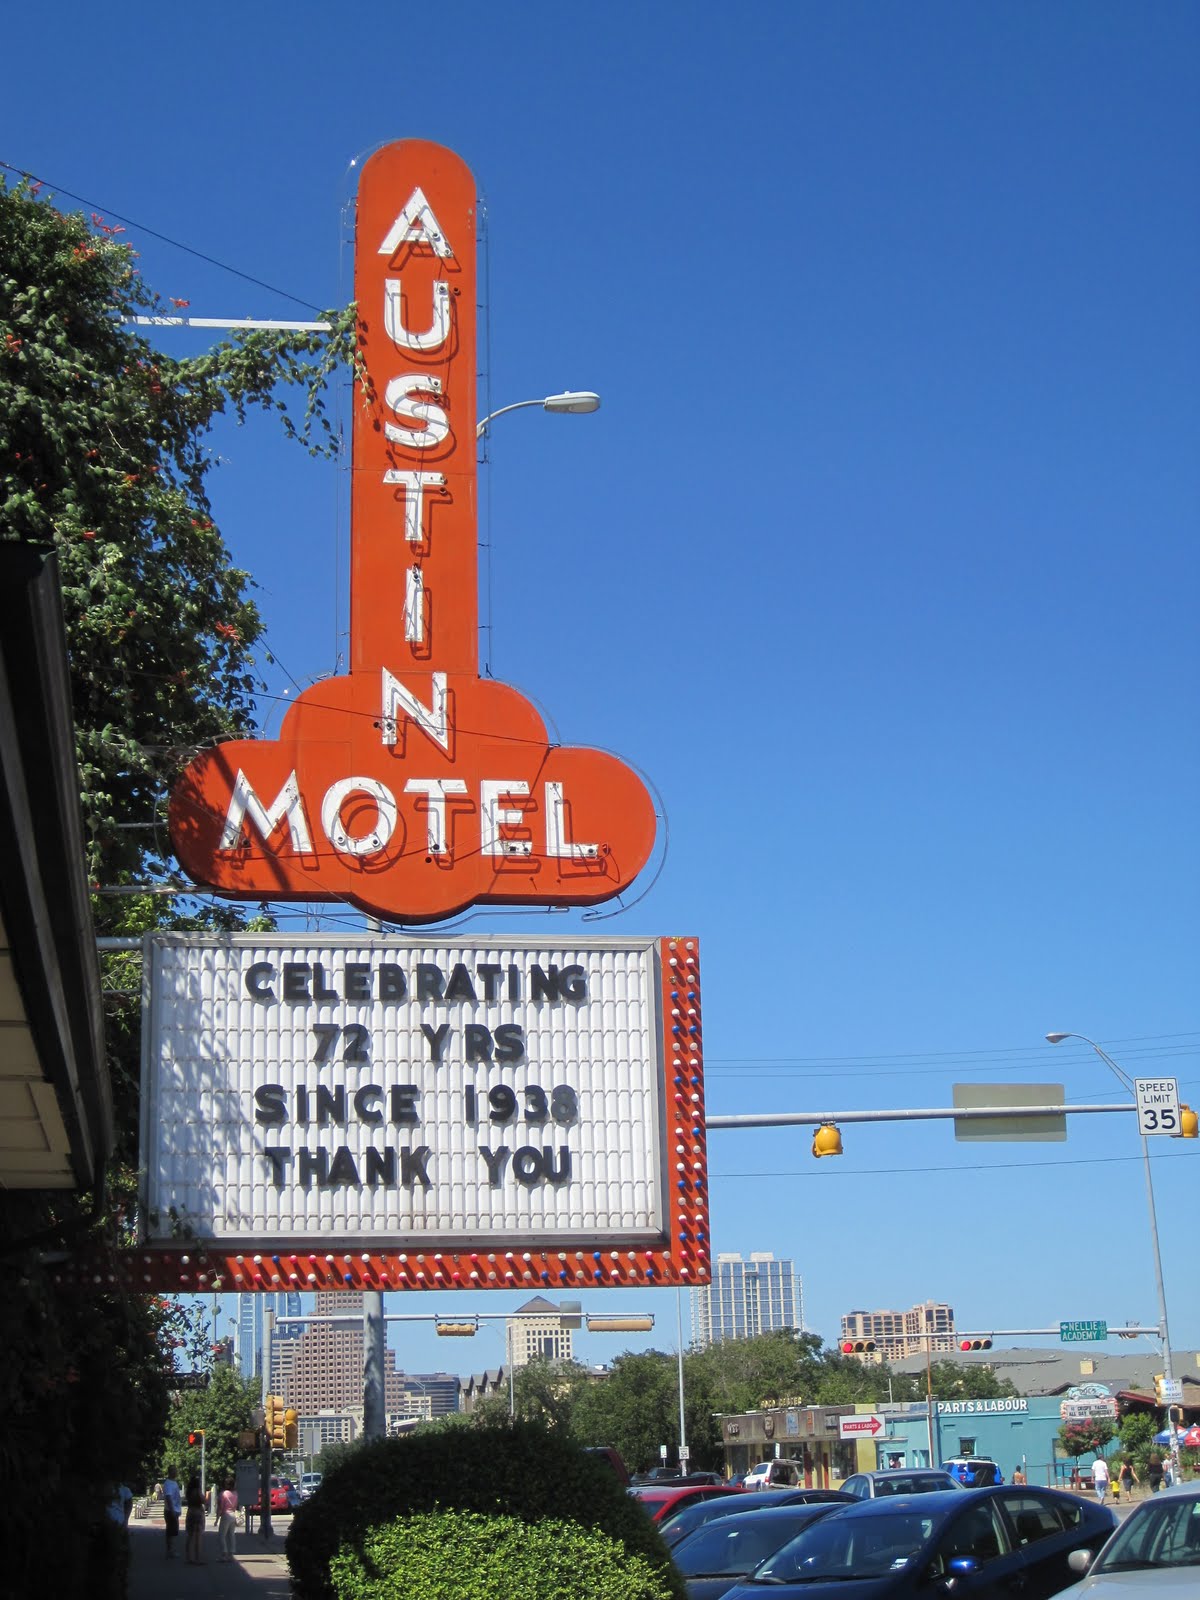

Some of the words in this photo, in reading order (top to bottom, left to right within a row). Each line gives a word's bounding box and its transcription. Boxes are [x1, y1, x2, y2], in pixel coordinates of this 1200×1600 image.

[378, 186, 453, 752] AUSTIN
[219, 767, 600, 856] MOTEL
[245, 961, 586, 1002] CELEBRATING
[312, 1023, 369, 1062] 72
[420, 1023, 525, 1062] YRS
[1139, 1083, 1174, 1092] SPEED
[1143, 1094, 1171, 1104] LIMIT
[255, 1084, 419, 1123] SINCE
[465, 1084, 578, 1123] 1938
[1143, 1109, 1176, 1130] 35
[264, 1145, 431, 1185] THANK
[478, 1145, 571, 1186] YOU
[1062, 1331, 1098, 1341] ACADEMY
[1068, 1321, 1098, 1331] NELLIE
[937, 1402, 974, 1413] PARTS
[976, 1401, 983, 1412] &
[984, 1400, 1028, 1412] LABOUR
